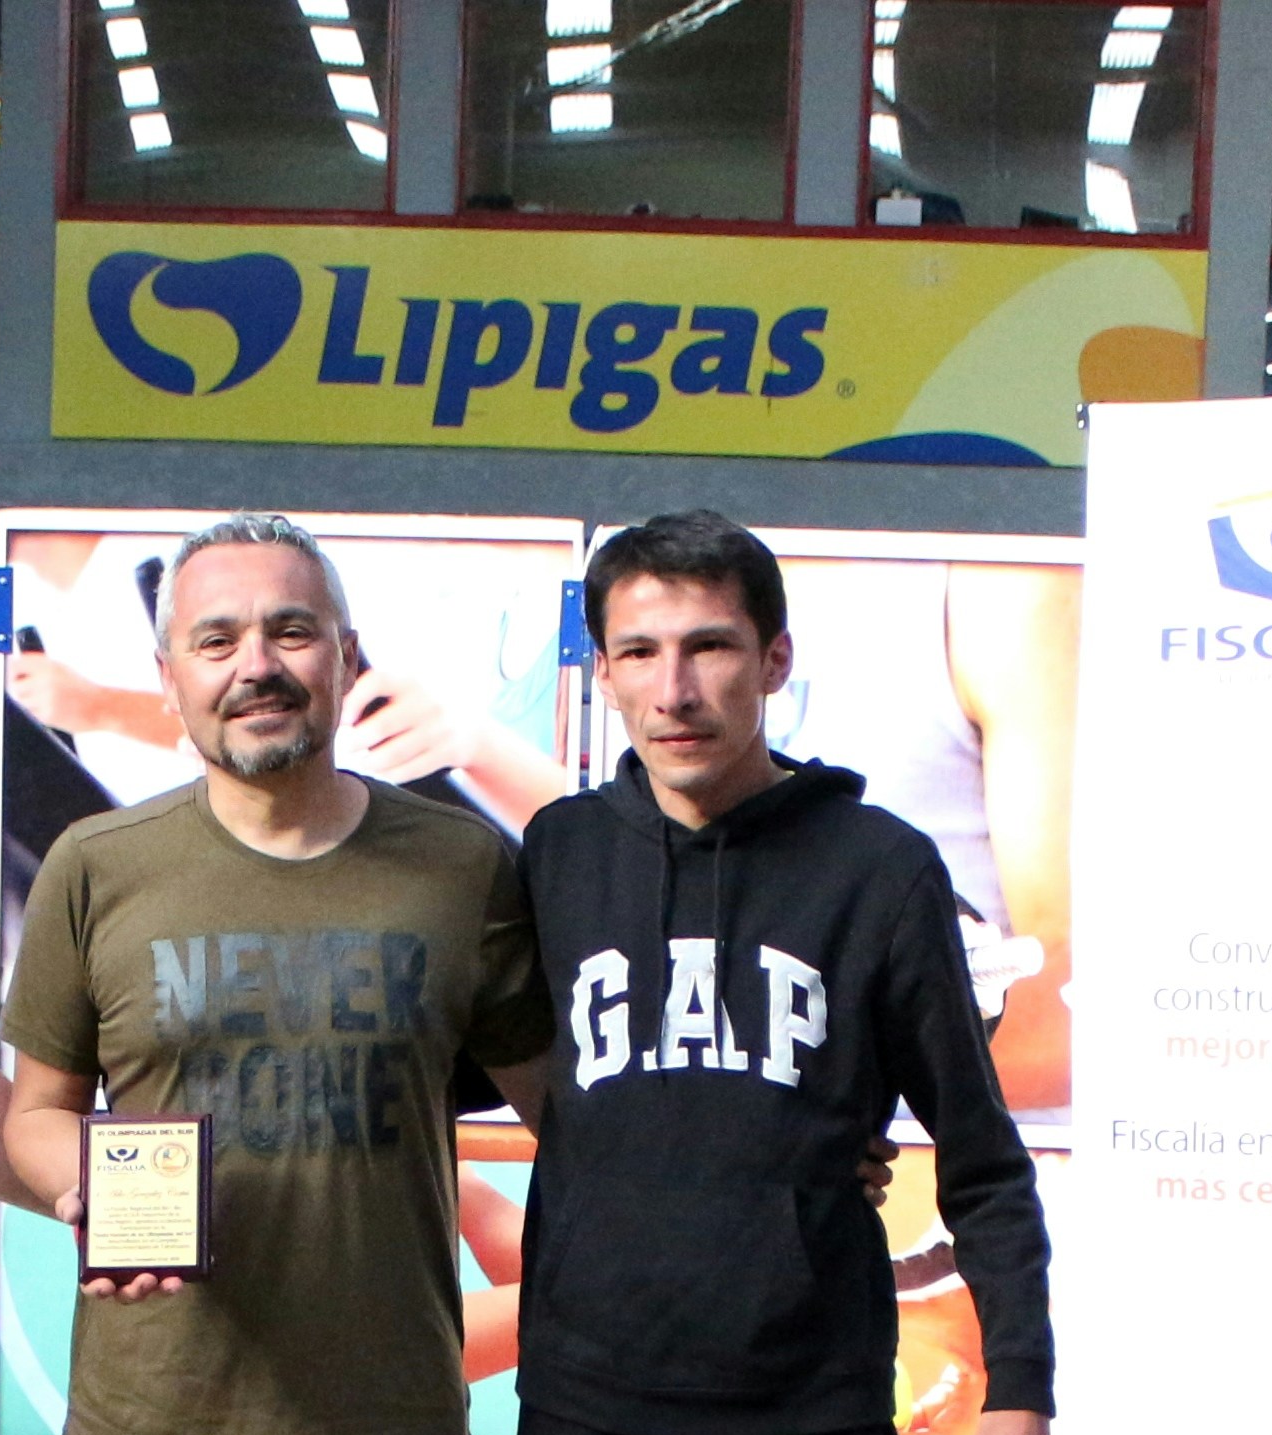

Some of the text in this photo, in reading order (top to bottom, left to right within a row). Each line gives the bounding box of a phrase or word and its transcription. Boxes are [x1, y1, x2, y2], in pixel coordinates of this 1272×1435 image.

[317, 264, 829, 432] Lipigas
[150, 930, 429, 1043] NEVER
[571, 937, 828, 1091] GAP
[1166, 1029, 1270, 1068] mejor
